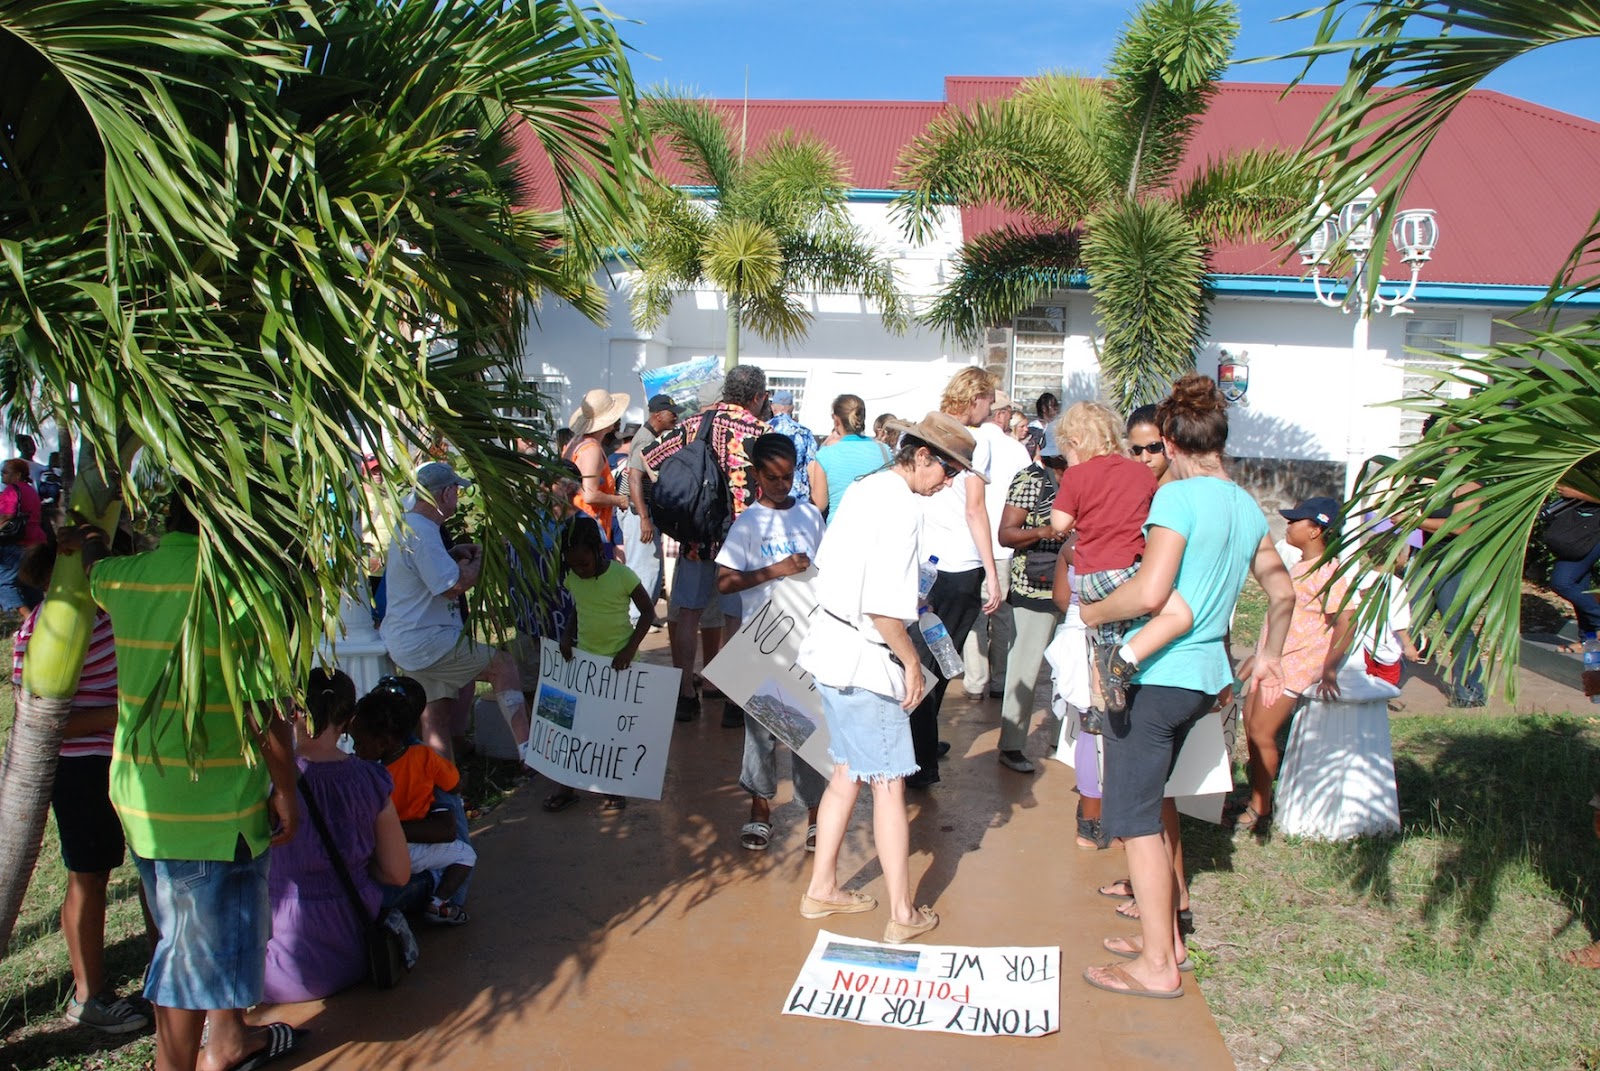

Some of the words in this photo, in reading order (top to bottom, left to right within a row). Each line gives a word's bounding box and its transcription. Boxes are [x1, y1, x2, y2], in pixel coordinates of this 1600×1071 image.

[760, 540, 800, 558] MAKE
[742, 599, 795, 655] NO
[543, 647, 649, 704] DEMOCRATIE
[617, 715, 639, 732] OF
[937, 952, 985, 981] WE
[1002, 954, 1055, 984] FOR
[832, 970, 970, 1003] POLLUTION
[788, 986, 870, 1022] THEM
[881, 997, 933, 1027] FOR
[945, 1004, 1050, 1034] MONEY
